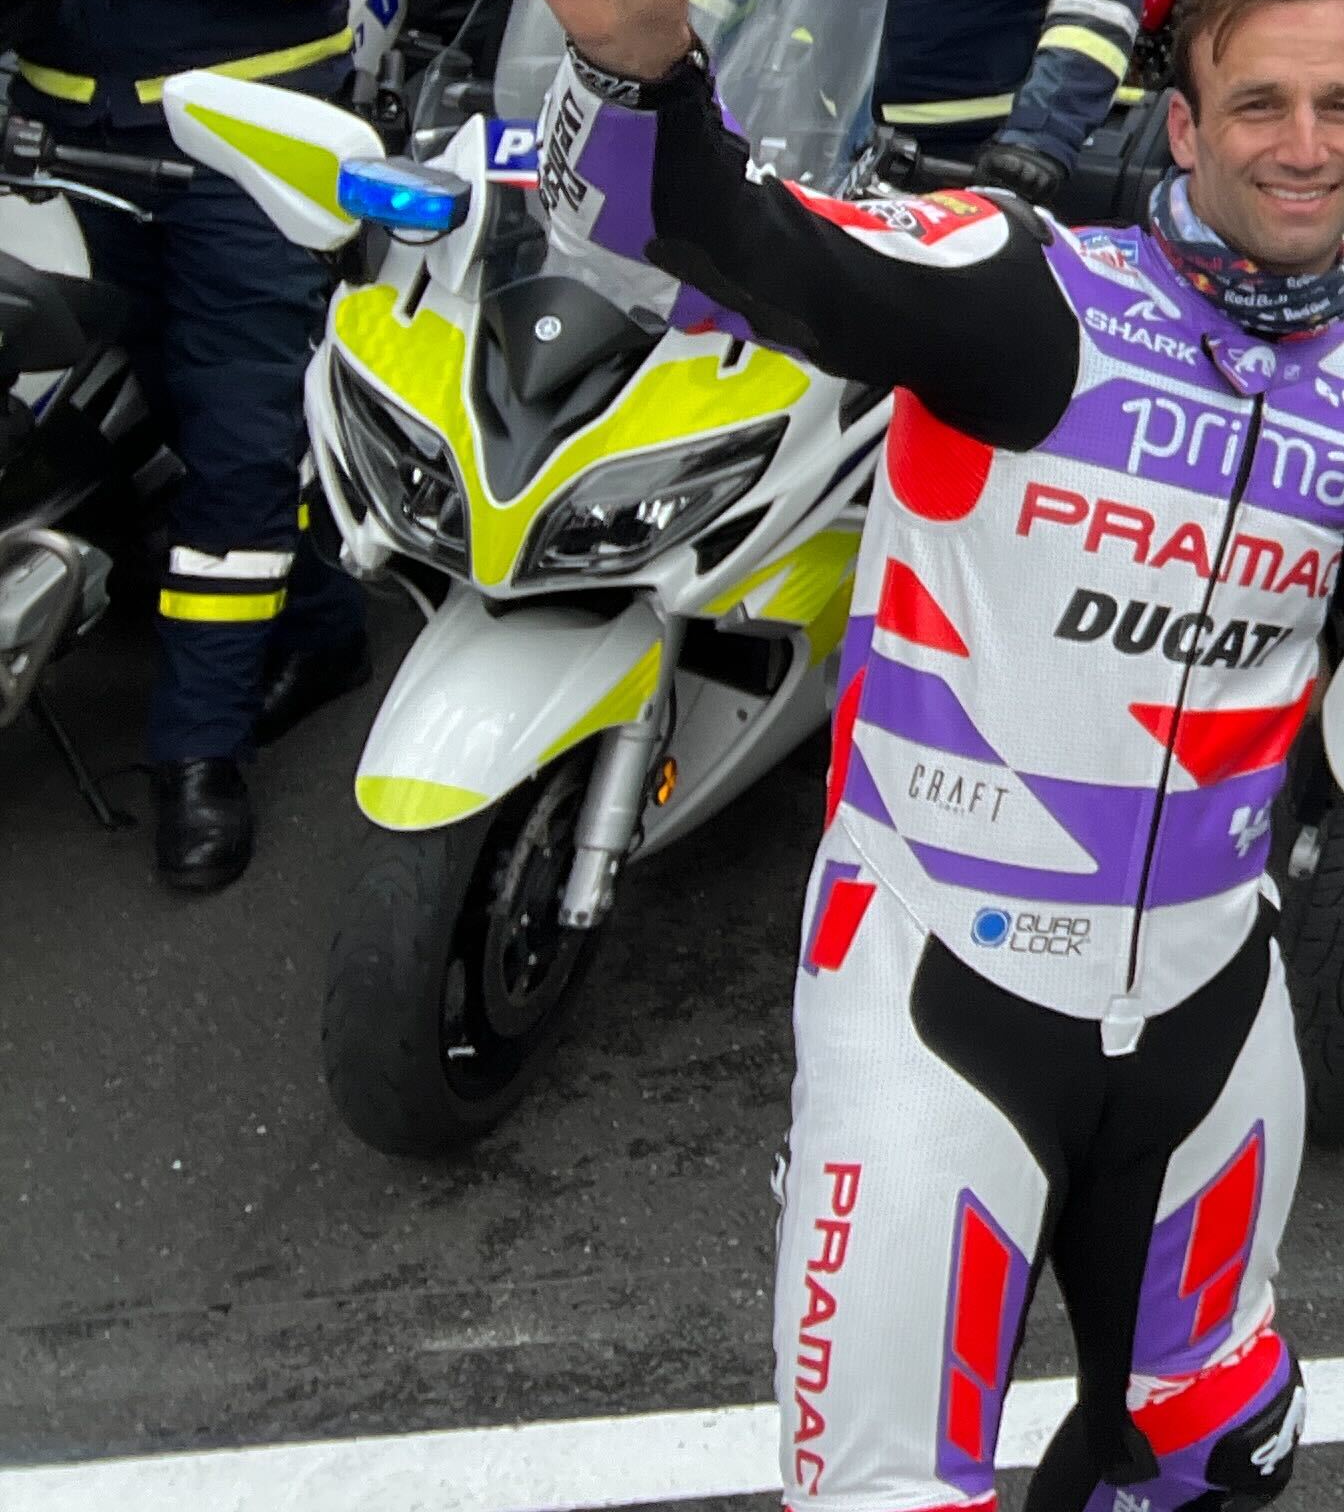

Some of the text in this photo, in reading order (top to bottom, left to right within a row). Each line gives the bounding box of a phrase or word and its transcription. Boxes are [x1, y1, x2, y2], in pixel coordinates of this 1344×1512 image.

[1084, 305, 1199, 366] SHARK
[908, 762, 1010, 823] CRAFT
[1010, 933, 1085, 956] LOCK
[1015, 913, 1091, 937] QUAD
[792, 1162, 862, 1495] PRAMAC
